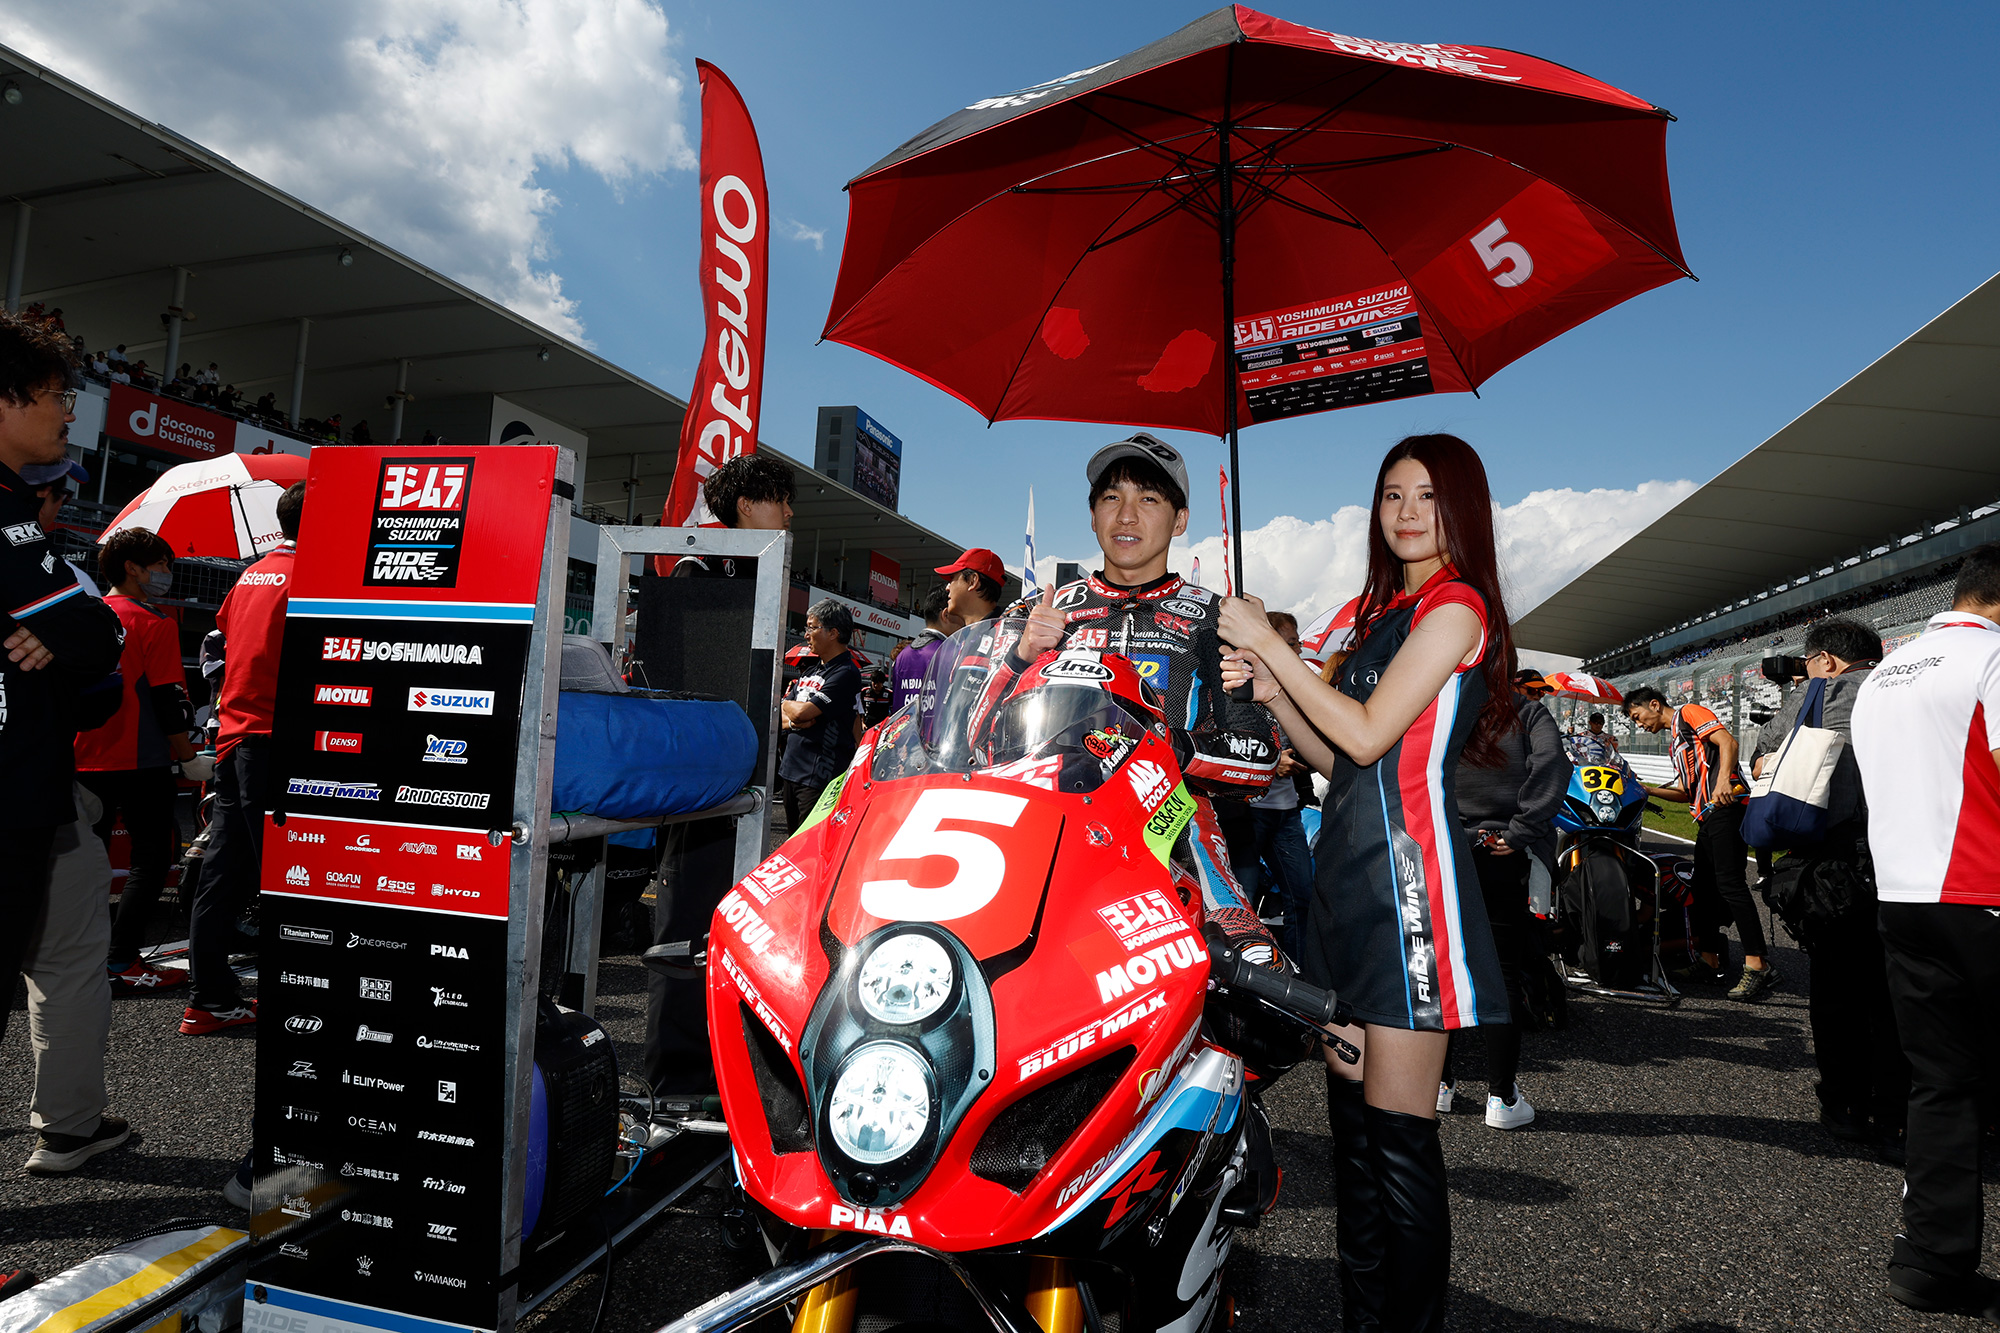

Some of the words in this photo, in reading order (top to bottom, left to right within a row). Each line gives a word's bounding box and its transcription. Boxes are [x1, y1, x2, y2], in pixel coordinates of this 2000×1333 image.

[1470, 217, 1534, 288] 5
[1276, 301, 1353, 324] YOSHIMURA
[1357, 286, 1408, 306] SUZUKI
[1282, 320, 1336, 338] RIDE
[1339, 308, 1388, 327] WIN
[1372, 325, 1400, 335] SUZUKI
[1309, 336, 1348, 348] YOSHIMURA
[1328, 346, 1350, 354] MOTUL
[160, 414, 215, 440] docomo
[865, 419, 893, 448] Panasonic
[159, 426, 216, 453] business
[165, 474, 231, 494] Astemo
[382, 466, 465, 508] ヨシムラ
[5, 523, 40, 538] RK
[377, 517, 460, 529] YOSHIMURA
[388, 530, 441, 541] SUZUKI
[375, 551, 439, 566] RIDE
[372, 566, 425, 581] WIN
[871, 570, 898, 590] HONDA
[1179, 594, 1209, 604] SUZUKI
[868, 612, 901, 630] Modulo
[1076, 608, 1103, 618] DENSO
[362, 641, 482, 664] YOSHIMURA
[1045, 660, 1104, 675] Arai
[317, 687, 369, 704] MOTUL
[430, 694, 489, 708] SUZUKI
[330, 738, 358, 747] DENSO
[427, 741, 467, 755] MFD
[1229, 738, 1269, 758] MFD
[1127, 760, 1166, 803] MAC
[1222, 770, 1250, 780] RIDE
[1584, 768, 1621, 789] 37
[288, 783, 333, 796] BLUE
[337, 787, 382, 800] MAX
[397, 786, 490, 809] BRIDGESTONE
[1142, 778, 1171, 812] TOOLS
[1147, 792, 1186, 836] GO&FUN
[457, 845, 482, 858] RK
[860, 788, 1029, 922] 5
[286, 865, 310, 880] MAC
[326, 872, 361, 884] GO&FUN
[286, 879, 310, 887] TOOLS
[388, 880, 415, 891] SDG
[444, 888, 480, 898] HYOD
[1404, 879, 1423, 932] WIN
[717, 890, 775, 957] MOTUL
[283, 928, 309, 938] Titanium
[310, 931, 329, 940] Power
[1123, 921, 1190, 951] YOSHIMURA
[430, 944, 469, 960] PIAA
[1096, 936, 1207, 1004] MOTUL
[1411, 936, 1431, 1003] RIDE
[361, 978, 391, 991] Baby
[361, 988, 391, 1000] Face
[721, 953, 755, 1005] BLUE
[756, 1001, 793, 1054] MAX
[1020, 1029, 1096, 1082] BLUE
[1102, 991, 1167, 1039] MAX
[377, 1079, 404, 1092] Power
[348, 1116, 397, 1132] OCEAN
[428, 1223, 457, 1236] TWT
[830, 1204, 913, 1239] PIAA
[424, 1273, 466, 1288] YAMAKOH
[243, 1307, 308, 1331] RIDE
